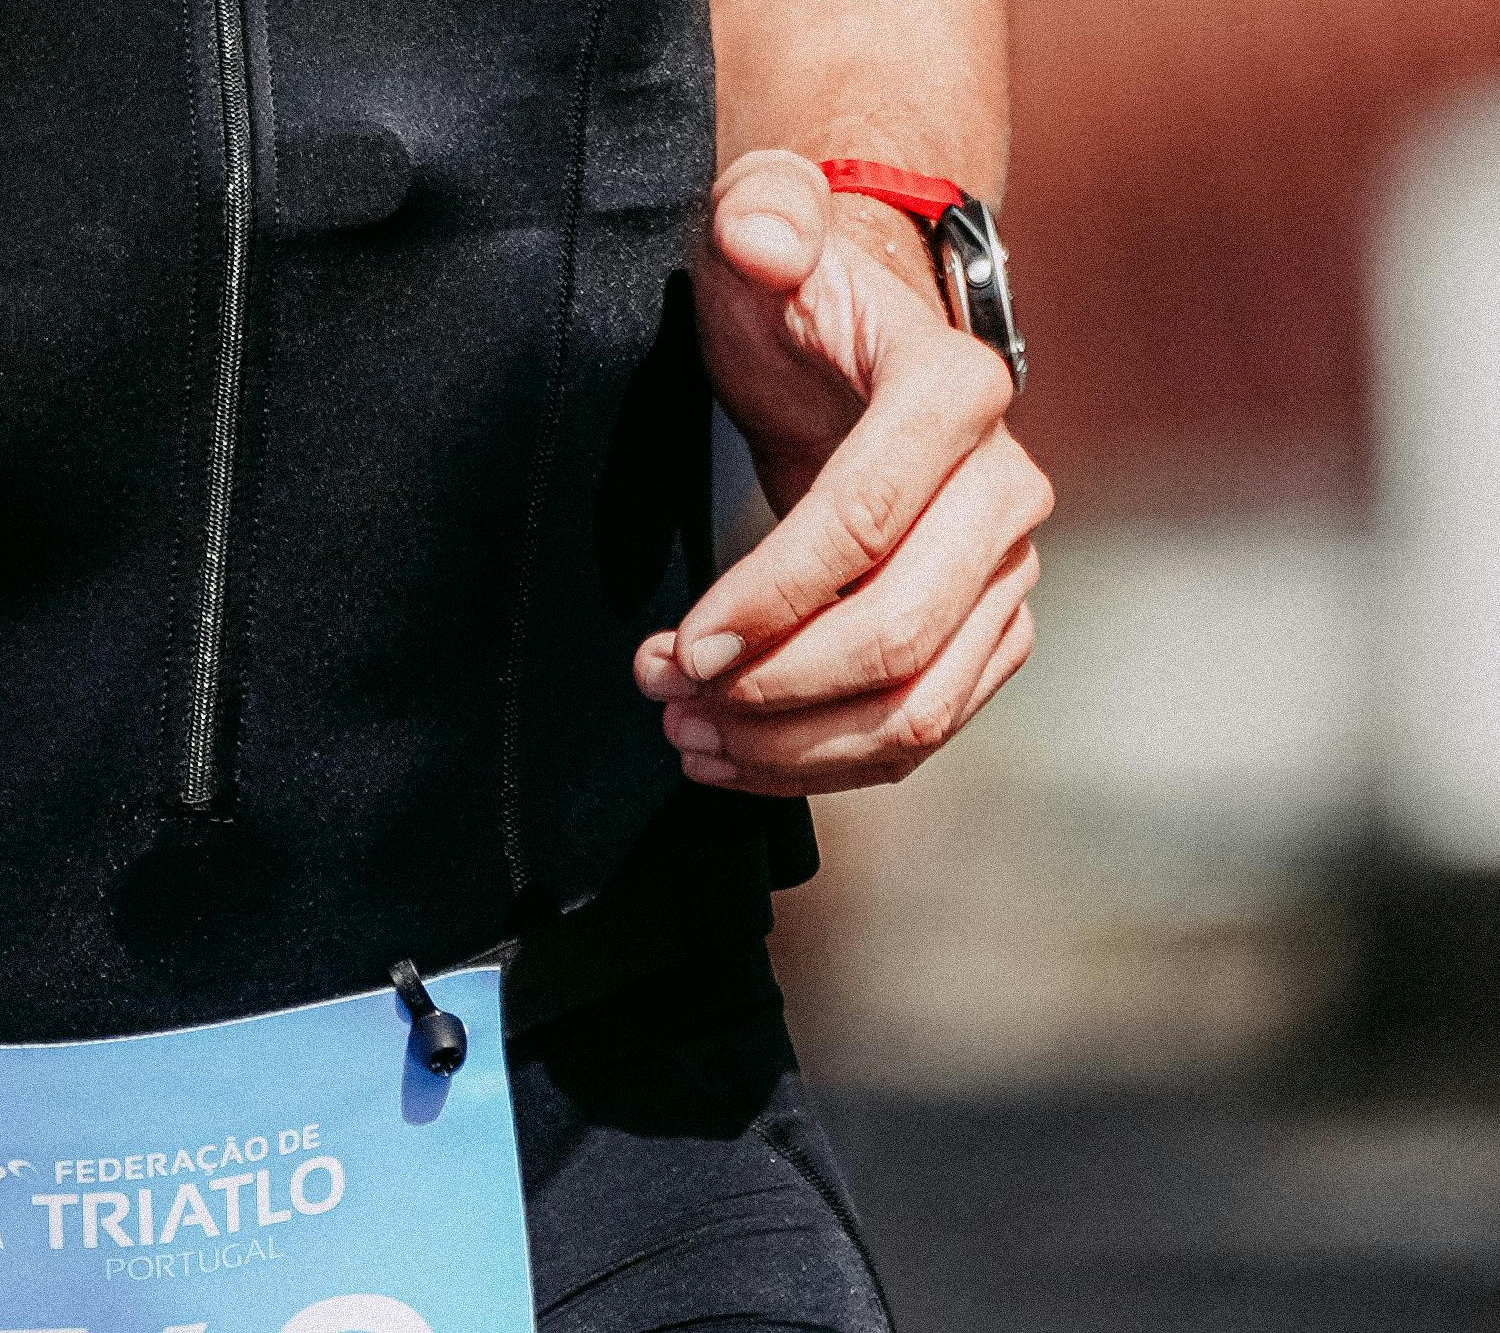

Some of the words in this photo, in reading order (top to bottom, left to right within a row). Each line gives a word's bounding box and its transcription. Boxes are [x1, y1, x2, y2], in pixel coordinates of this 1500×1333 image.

[55, 1136, 268, 1184] FEDERAÇÃO
[278, 1124, 321, 1155] DE
[32, 1156, 345, 1250] TRIATLO
[105, 1236, 285, 1281] PORTUGAL
